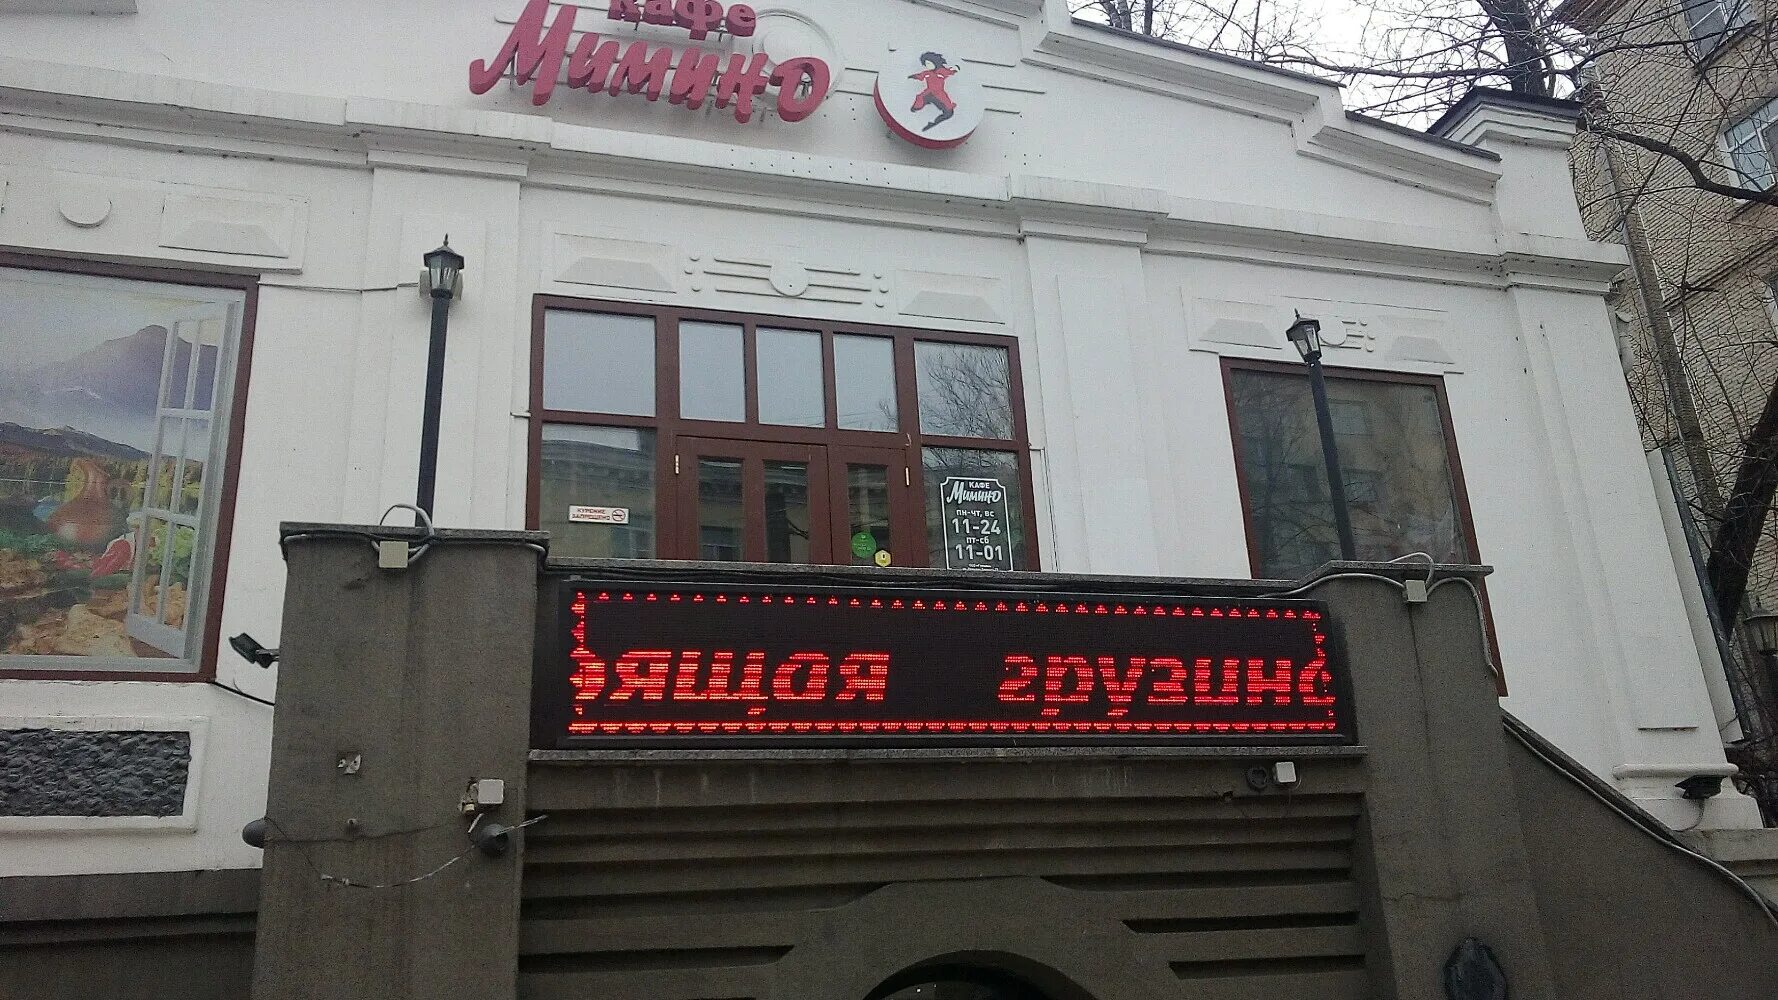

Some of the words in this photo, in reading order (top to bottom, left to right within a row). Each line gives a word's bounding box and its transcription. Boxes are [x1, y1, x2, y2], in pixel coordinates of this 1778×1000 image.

[469, 0, 830, 123] Мимино
[946, 481, 1002, 504] Мимино
[968, 481, 990, 489] КАФЕ
[952, 518, 1001, 535] 11-24
[955, 544, 1003, 561] 11-01
